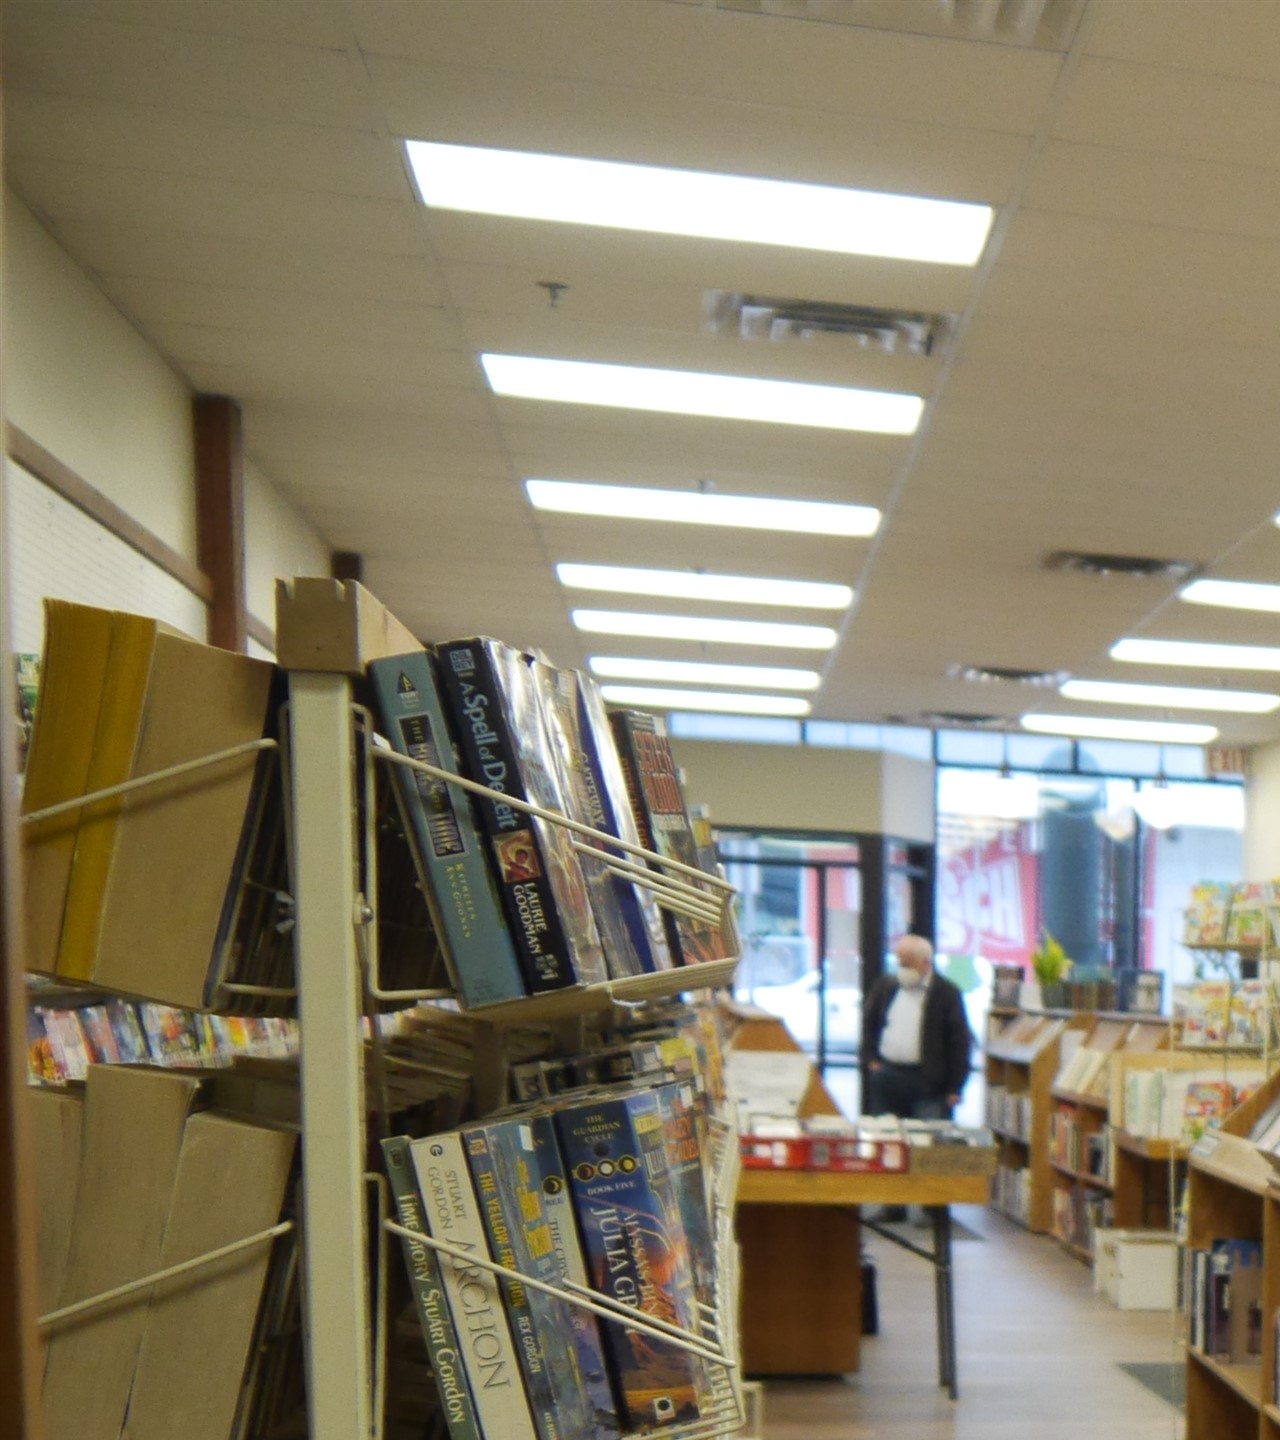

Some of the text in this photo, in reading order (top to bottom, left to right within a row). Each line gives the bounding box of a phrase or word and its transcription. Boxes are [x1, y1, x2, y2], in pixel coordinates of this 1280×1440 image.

[463, 693, 498, 746] Spell
[513, 885, 541, 953] GOODMAN
[525, 882, 548, 933] LAURIE
[428, 1167, 453, 1230] GORDON
[445, 1170, 467, 1219] STUART
[591, 1207, 628, 1272] JULIA
